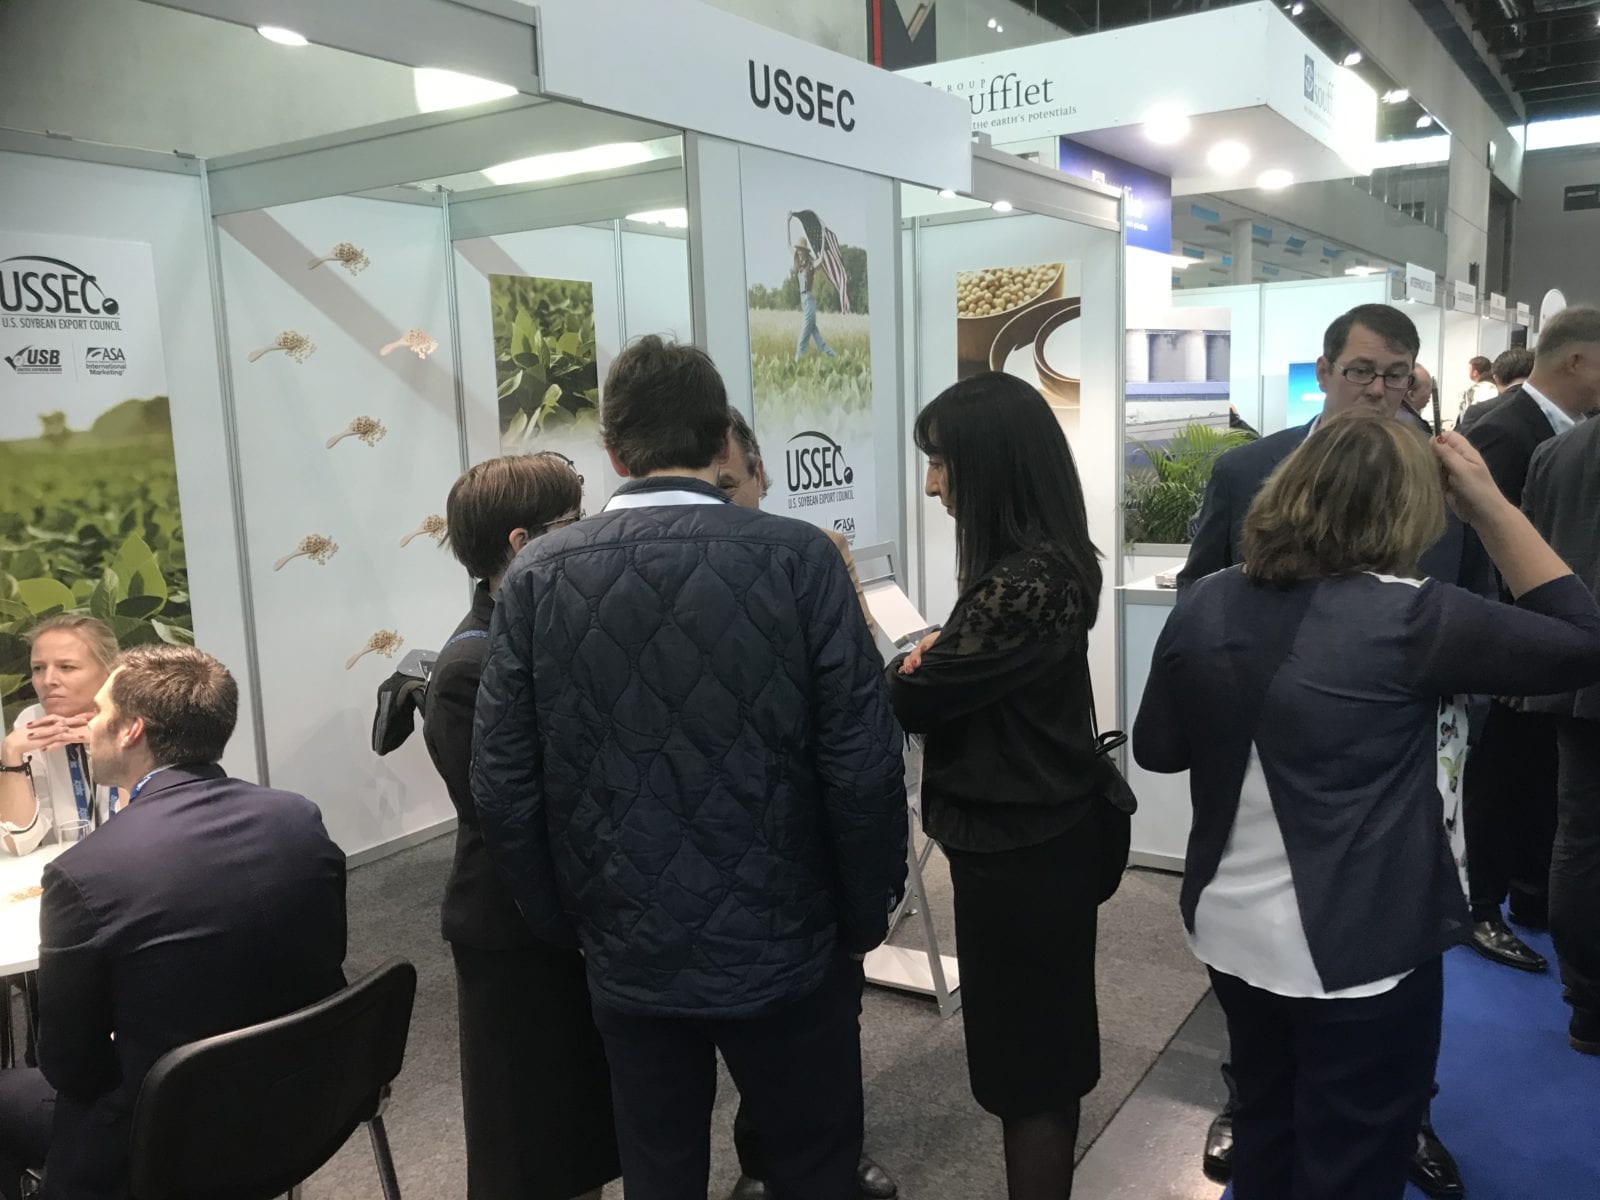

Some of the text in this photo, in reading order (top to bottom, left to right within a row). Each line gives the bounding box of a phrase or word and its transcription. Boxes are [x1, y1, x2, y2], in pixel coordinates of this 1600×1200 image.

[748, 59, 855, 132] USSEC
[968, 72, 1054, 115] ufflet
[0, 270, 100, 315] USSEC
[2, 317, 121, 331] U.S. SOYBEAN EXPORT COUNCIL
[27, 349, 60, 365] USB
[102, 347, 126, 361] ASA
[786, 445, 843, 492] USSEC
[842, 517, 855, 532] ASA
